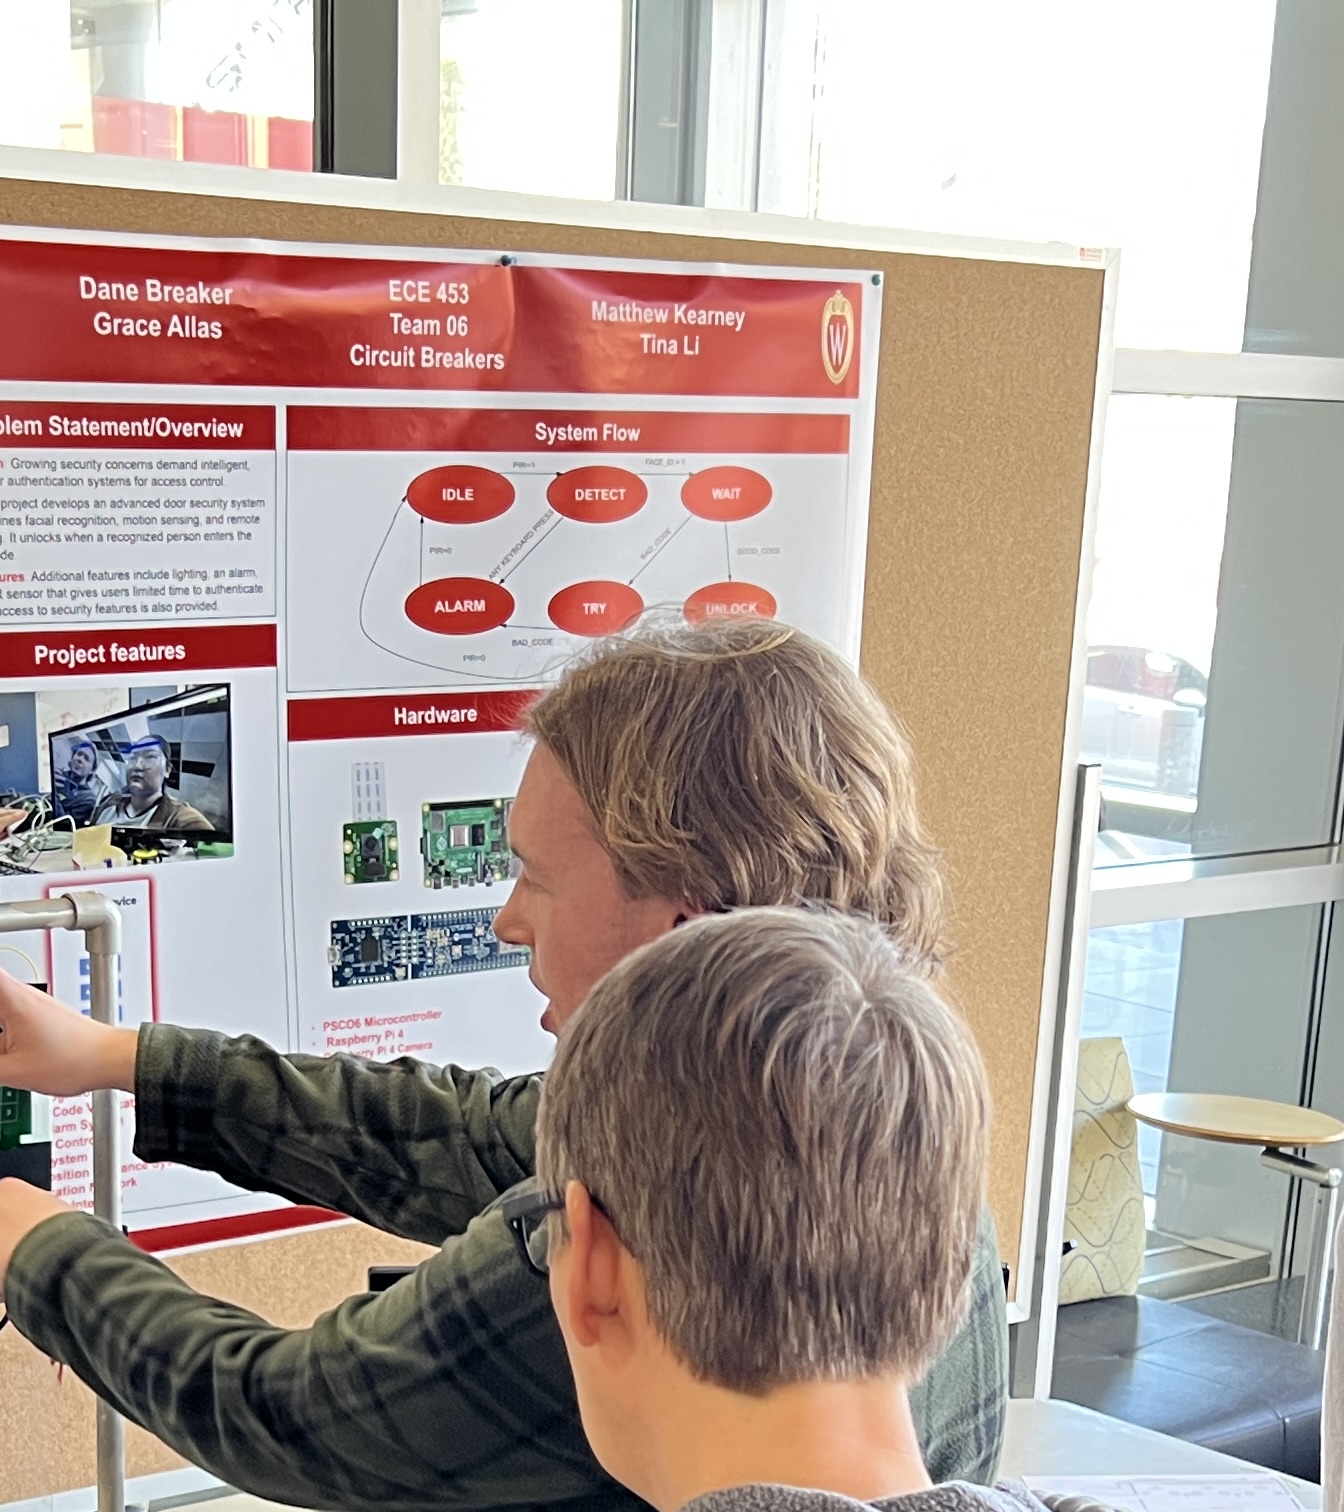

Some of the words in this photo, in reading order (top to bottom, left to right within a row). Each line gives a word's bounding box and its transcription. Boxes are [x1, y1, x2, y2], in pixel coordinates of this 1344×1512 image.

[79, 275, 139, 301] Dane
[146, 278, 234, 304] Breaker
[388, 279, 430, 302] ECE
[435, 282, 470, 304] 453
[591, 300, 668, 324] Matthew
[674, 303, 746, 331] Kearney
[93, 312, 162, 337] Grace
[390, 313, 440, 335] Team
[446, 315, 469, 337] 06
[640, 333, 678, 354] Tina
[683, 335, 699, 355] Li
[829, 322, 847, 366] W
[349, 344, 415, 368] Circuit
[421, 346, 505, 370] Breakers
[48, 415, 244, 439] Statement/Overview
[534, 422, 598, 446] System
[602, 423, 641, 442] Flow
[10, 457, 57, 472] Growing
[60, 458, 102, 472] security
[105, 461, 154, 470] concerns
[156, 460, 198, 470] demand
[8, 475, 84, 486] authentication
[87, 476, 132, 489] systems
[134, 476, 148, 486] for
[151, 477, 187, 487] access
[442, 488, 475, 501] IDLE
[574, 488, 627, 501] DETECT
[711, 487, 741, 501] WAIT
[0, 498, 39, 512] project
[41, 498, 90, 511] develops
[93, 500, 107, 509] an
[110, 498, 161, 509] advanced
[163, 498, 187, 509] door
[189, 498, 228, 511] security
[230, 498, 265, 510] system
[25, 514, 53, 526] facial
[122, 515, 158, 525] motion
[205, 514, 224, 525] and
[226, 516, 260, 525] remote
[9, 532, 17, 543] It
[19, 531, 62, 543] unlocks
[64, 531, 94, 542] when
[96, 534, 104, 542] a
[106, 531, 164, 544] recognized
[166, 533, 201, 543] person
[203, 531, 235, 541] enters
[236, 530, 252, 540] the
[30, 570, 85, 582] Additional
[87, 570, 131, 581] features
[133, 569, 170, 580] include
[213, 569, 226, 578] an
[6, 589, 44, 599] sensor
[46, 588, 68, 599] that
[70, 588, 98, 601] gives
[101, 588, 130, 598] users
[132, 585, 166, 597] limited
[168, 585, 190, 596] time
[192, 585, 202, 595] to
[37, 605, 48, 616] to
[51, 605, 93, 618] security
[95, 603, 137, 615] features
[140, 602, 149, 613] is
[151, 601, 173, 613] also
[434, 599, 486, 613] ALARM
[582, 602, 607, 615] TRY
[706, 602, 757, 616] UNLOCK
[34, 644, 106, 669] Project
[109, 642, 186, 662] features
[393, 706, 478, 726] Hardware
[364, 1010, 443, 1028] Microcontroller
[326, 1033, 382, 1048] Raspberry
[384, 1029, 395, 1041] Pi
[397, 1029, 404, 1039] 4
[389, 1044, 395, 1054] 4
[397, 1041, 433, 1054] Camera
[52, 1104, 83, 1117] Code
[51, 1154, 88, 1168] ystem
